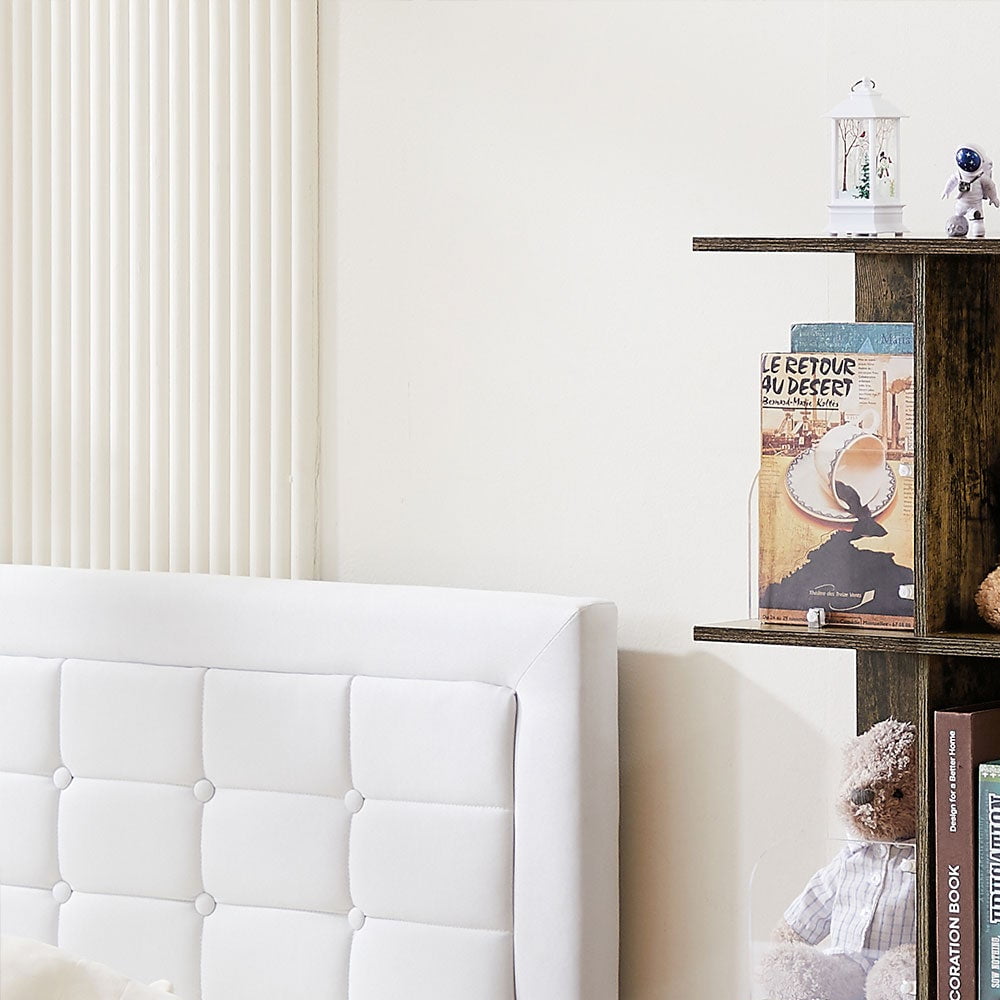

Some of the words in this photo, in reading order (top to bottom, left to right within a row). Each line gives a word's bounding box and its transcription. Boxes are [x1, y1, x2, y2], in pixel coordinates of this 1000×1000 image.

[762, 356, 782, 374] LE
[785, 356, 856, 376] RETOUR
[762, 375, 784, 394] AU
[788, 377, 854, 397] DESERT
[948, 864, 960, 914] BOOK
[991, 971, 1000, 989] SOW
